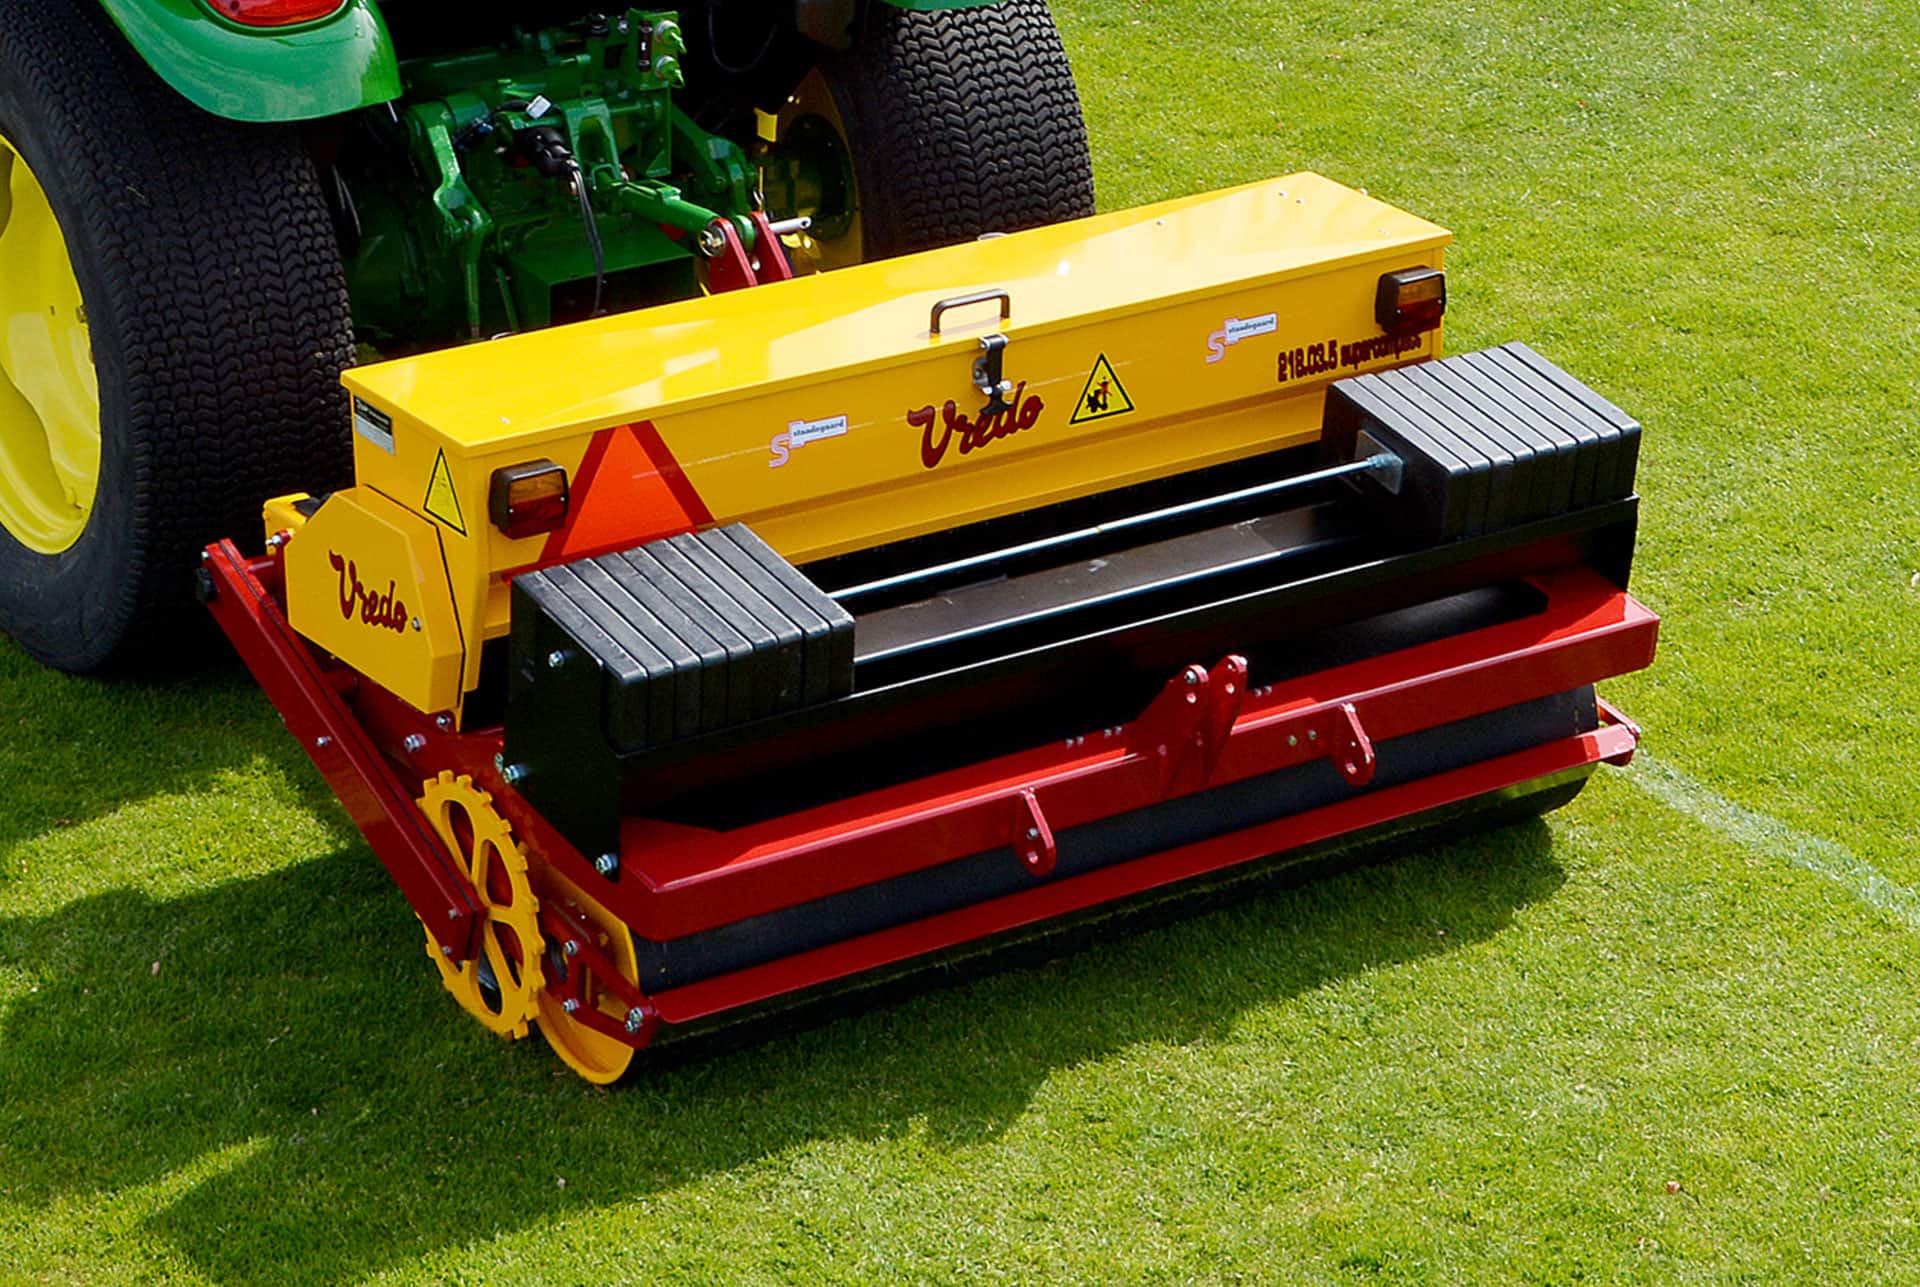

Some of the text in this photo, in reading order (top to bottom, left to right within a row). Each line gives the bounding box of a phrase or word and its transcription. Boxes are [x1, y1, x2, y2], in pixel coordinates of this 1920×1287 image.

[1278, 339, 1338, 382] 218.03.5
[907, 381, 1044, 469] Vredo
[328, 549, 408, 634] Vredo
